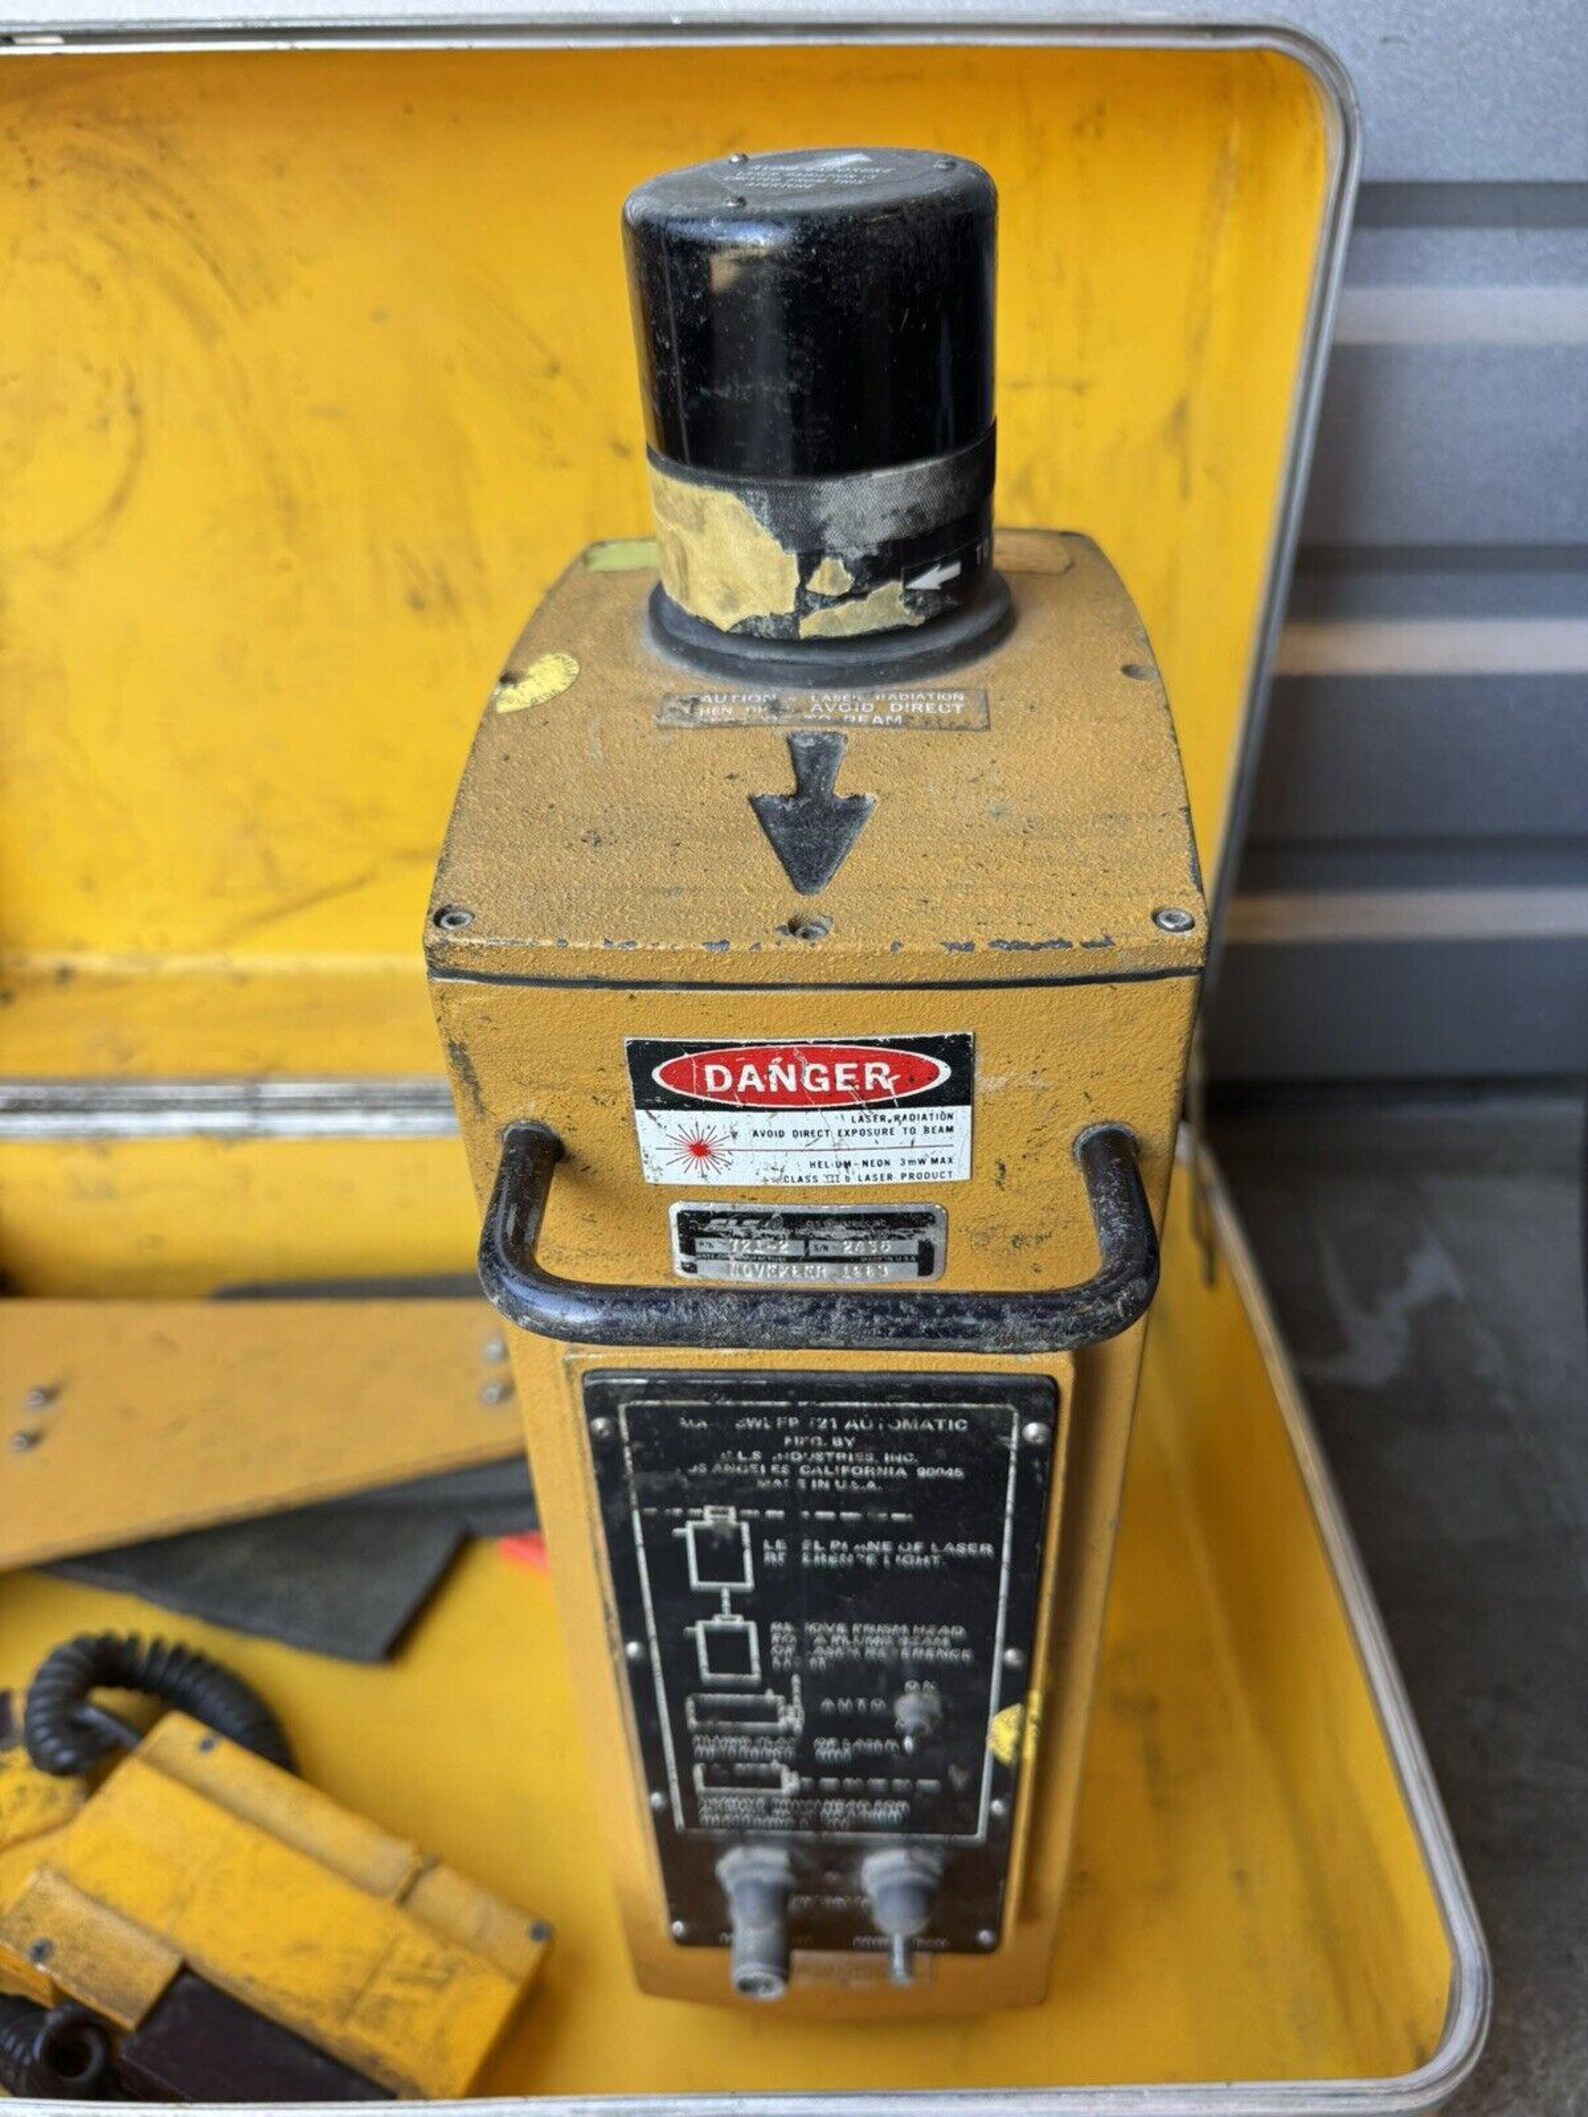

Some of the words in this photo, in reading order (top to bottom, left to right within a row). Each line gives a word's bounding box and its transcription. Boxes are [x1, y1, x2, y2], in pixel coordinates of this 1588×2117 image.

[701, 693, 775, 704] AUTION
[810, 703, 875, 714] AVOID
[890, 702, 964, 714] DIRECT
[703, 1062, 892, 1094] DANGER
[851, 1114, 886, 1124] LASER
[894, 1112, 955, 1123] RADIATION
[752, 1129, 786, 1138] AVOID
[792, 1128, 831, 1138] DIRECT
[837, 1127, 896, 1138] EXPOSURE
[902, 1126, 917, 1135] TO
[923, 1125, 955, 1135] BEAM
[931, 1157, 954, 1166] MAX
[784, 1174, 818, 1184] CLASS
[857, 1172, 894, 1182] LASER
[900, 1170, 954, 1181] PRODUCT
[729, 1263, 827, 1278] NOVEMBER
[843, 1417, 969, 1432] AUTOMATIC
[831, 1436, 856, 1448] BY
[884, 1452, 919, 1464] INC.
[799, 1464, 908, 1479] CALIFORNIA
[810, 1479, 831, 1491] IN
[763, 1539, 825, 1553] LEEL
[930, 1542, 995, 1557] LASER
[763, 1552, 878, 1568] REERENCE
